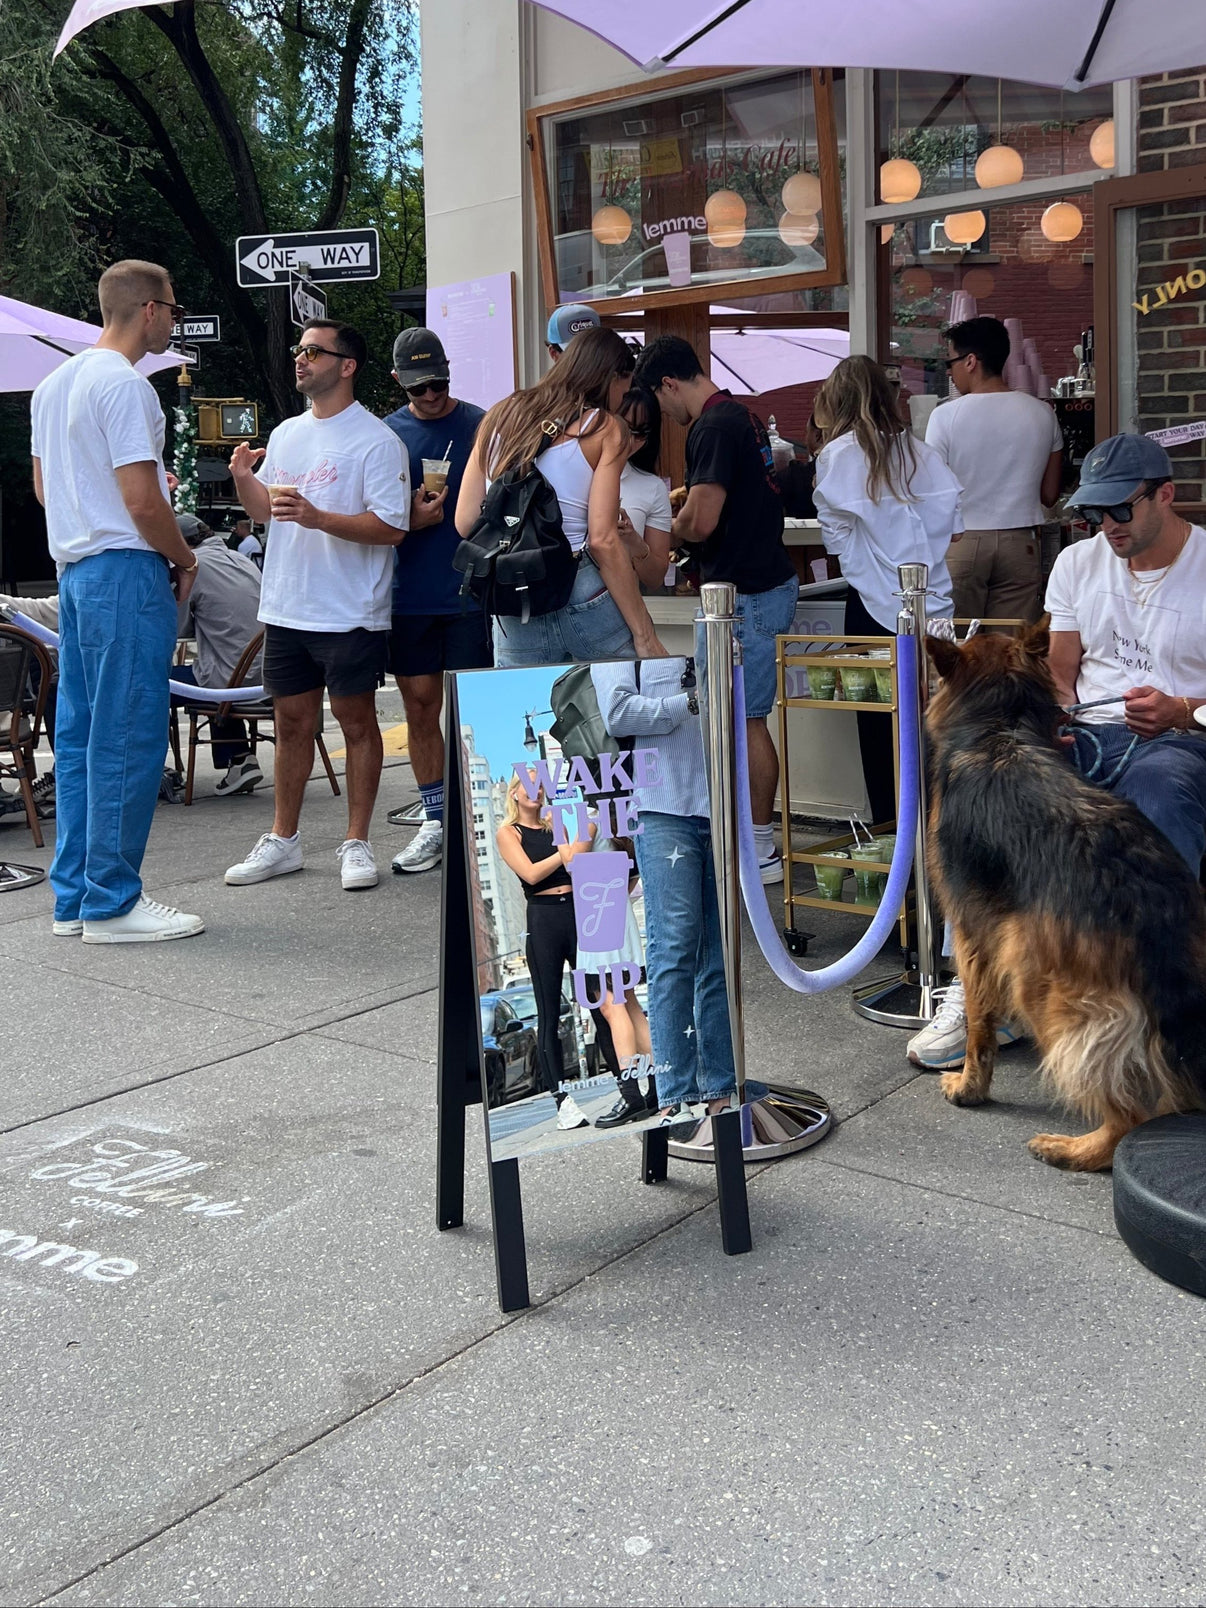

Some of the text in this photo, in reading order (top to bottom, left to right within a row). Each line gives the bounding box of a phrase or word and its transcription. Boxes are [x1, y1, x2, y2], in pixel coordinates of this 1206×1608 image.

[643, 215, 707, 241] lemme
[257, 244, 365, 270] ONE WAY
[297, 290, 325, 320] ONE WAY
[186, 323, 209, 334] WAY
[1169, 426, 1188, 436] YOUR
[1190, 423, 1204, 432] DAY
[1190, 430, 1205, 439] WAY
[1135, 658, 1153, 673] Me
[511, 747, 663, 802] WAKE
[541, 796, 645, 847] THE
[579, 877, 625, 937] F
[571, 961, 641, 1010] UP
[558, 1076, 609, 1094] lemme
[620, 1053, 672, 1081] Fellini
[70, 1195, 146, 1218] COFFEE
